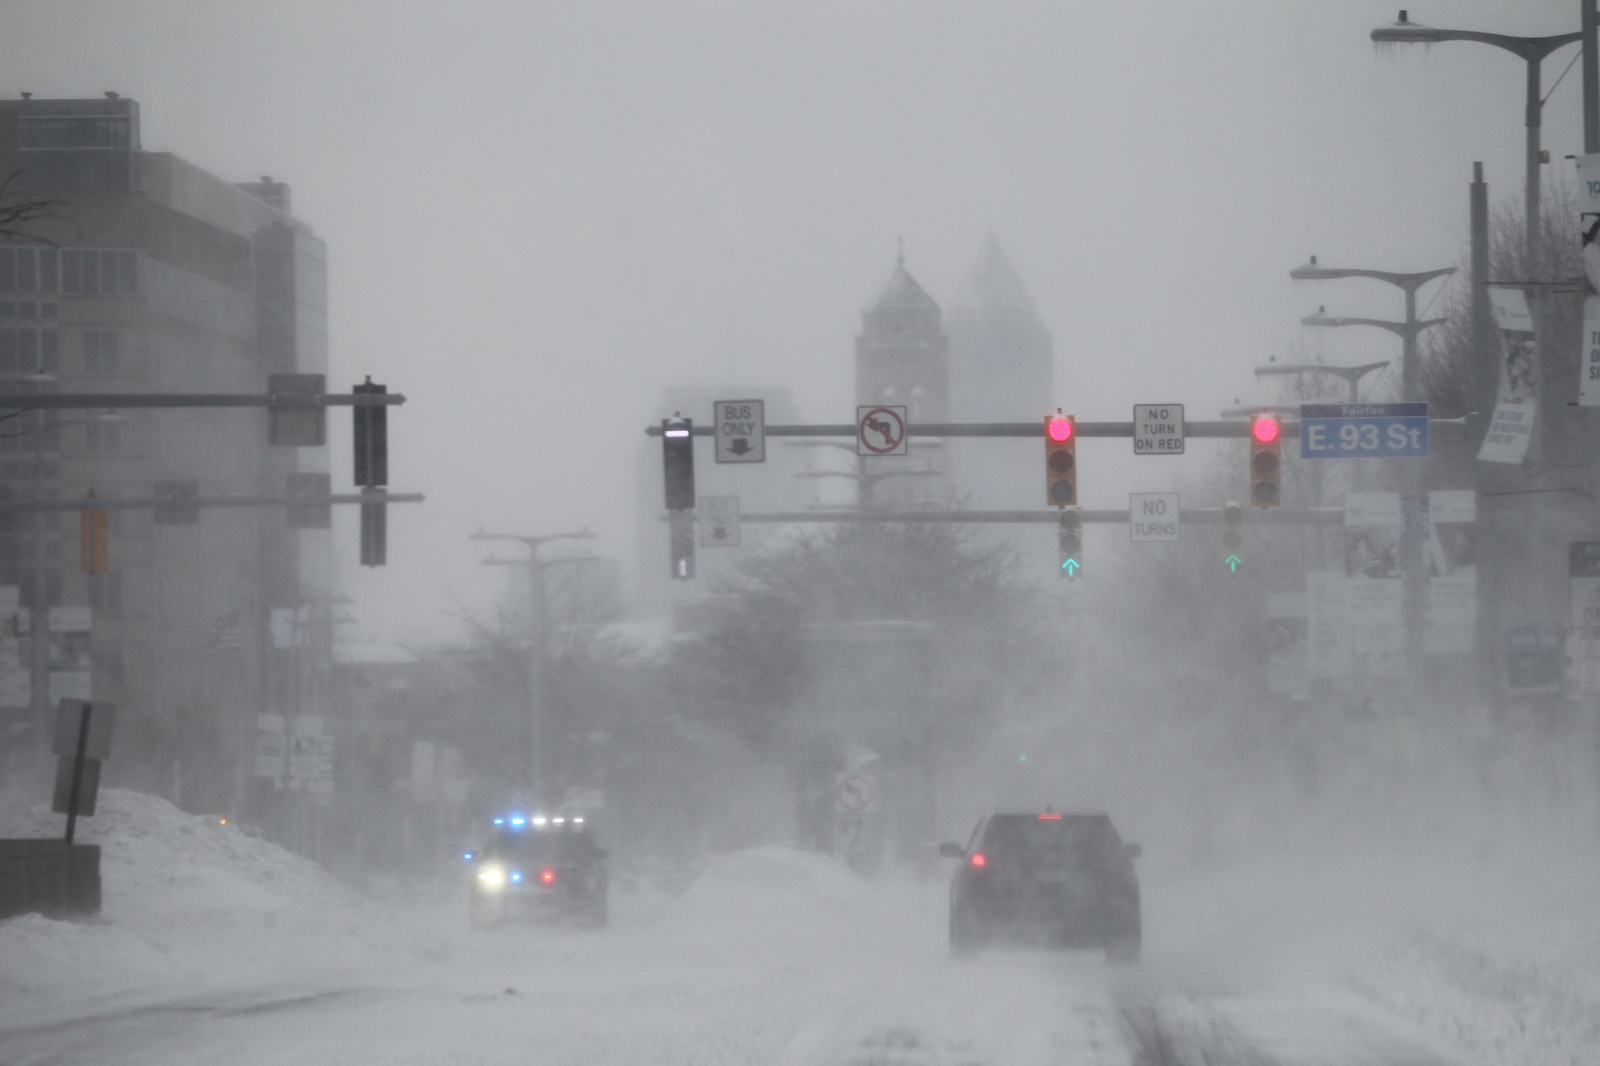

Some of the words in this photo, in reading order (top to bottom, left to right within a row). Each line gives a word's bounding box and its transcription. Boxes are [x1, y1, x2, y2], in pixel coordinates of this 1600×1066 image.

[725, 405, 752, 420] BUS
[1148, 409, 1169, 420] NO
[1341, 404, 1385, 416] Fairfax
[723, 421, 755, 436] ONLY
[1142, 424, 1175, 435] TURN
[1387, 423, 1422, 449] St
[1136, 439, 1153, 450] ON
[1158, 438, 1182, 450] RED
[1143, 500, 1166, 515] NO
[1134, 522, 1176, 536] TURNS
